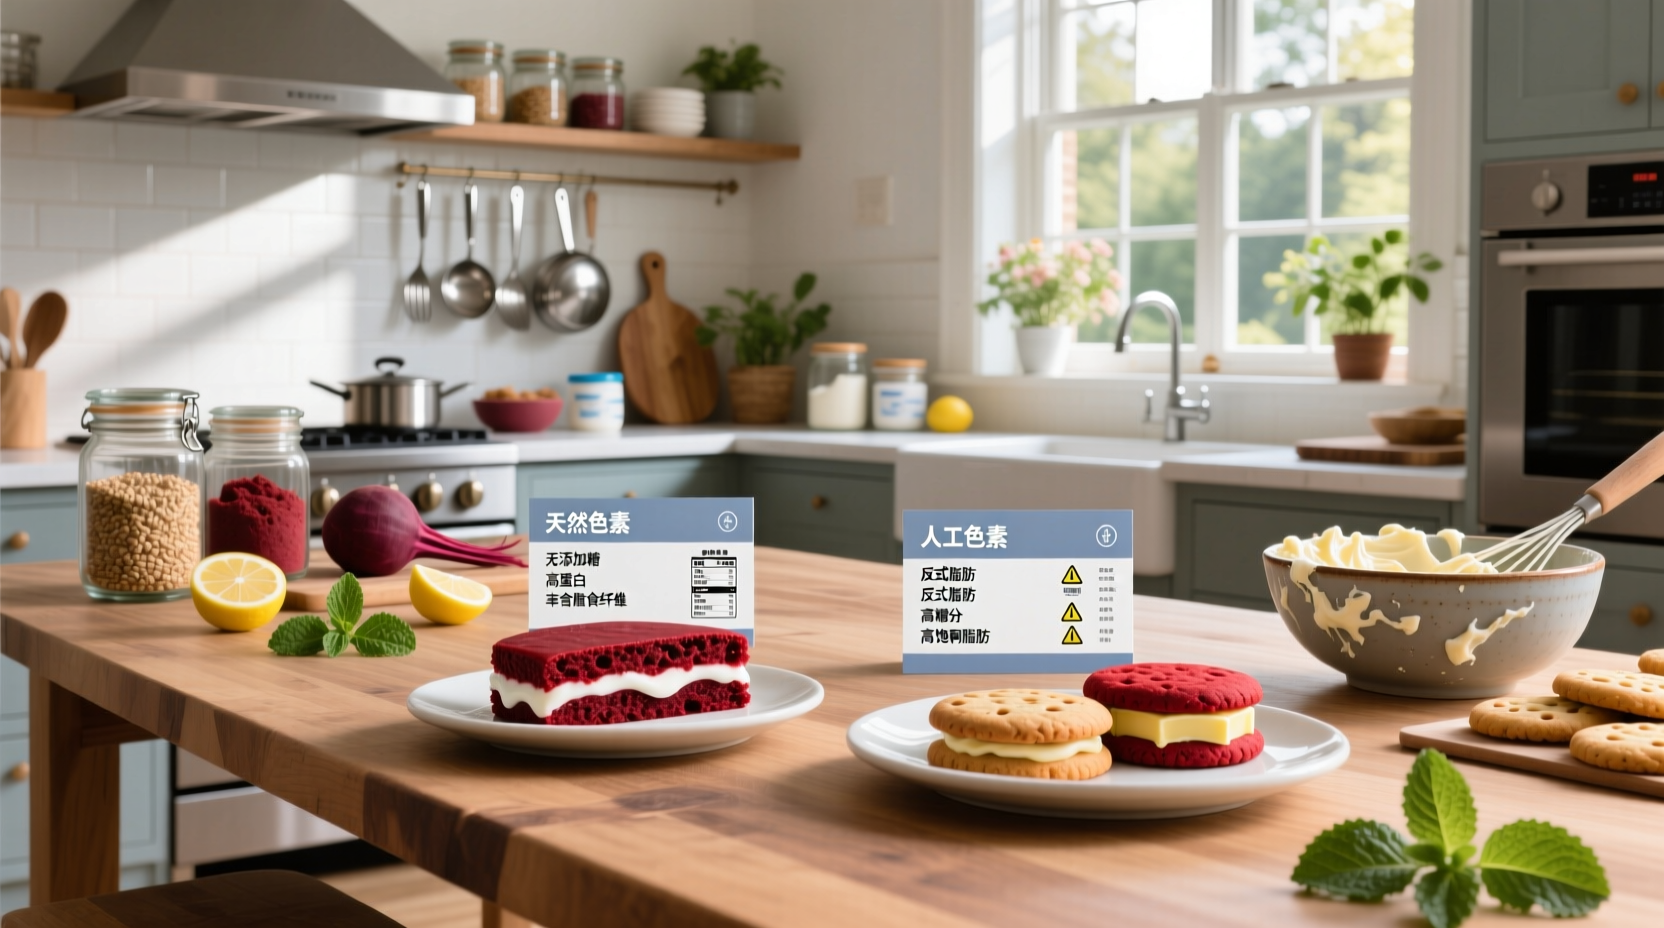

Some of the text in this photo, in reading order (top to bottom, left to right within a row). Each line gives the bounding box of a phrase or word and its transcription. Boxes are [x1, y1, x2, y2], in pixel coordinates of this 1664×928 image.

[545, 511, 631, 534] 天然色素
[921, 525, 1008, 548] 人工色素
[921, 566, 977, 582] 反式脂肪
[921, 586, 977, 602] 反式脂肪
